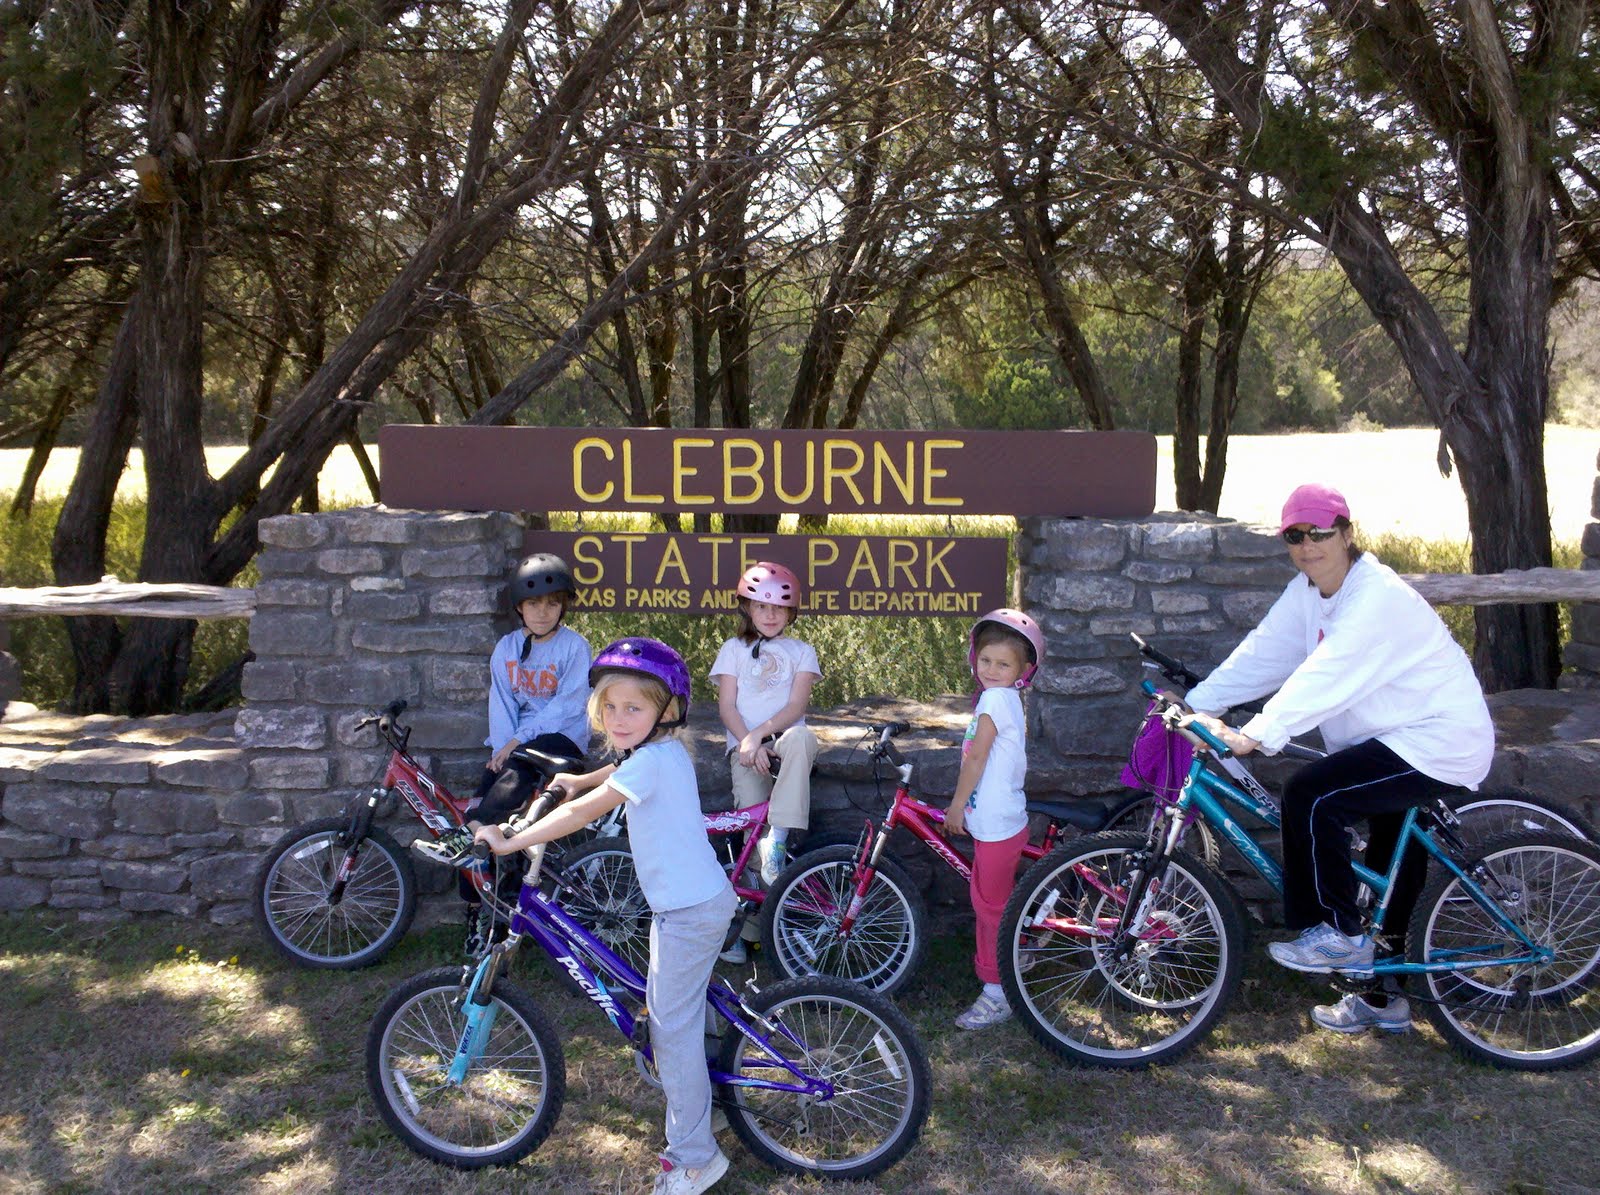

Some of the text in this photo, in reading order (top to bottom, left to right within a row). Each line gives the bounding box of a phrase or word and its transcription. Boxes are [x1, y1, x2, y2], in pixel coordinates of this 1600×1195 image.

[573, 437, 965, 506] CLEBURNE
[573, 536, 956, 589] STATE PARK
[574, 587, 982, 612] XAS PARKS AND LIFE DEPARTMENT
[556, 956, 620, 1018] Pacific
